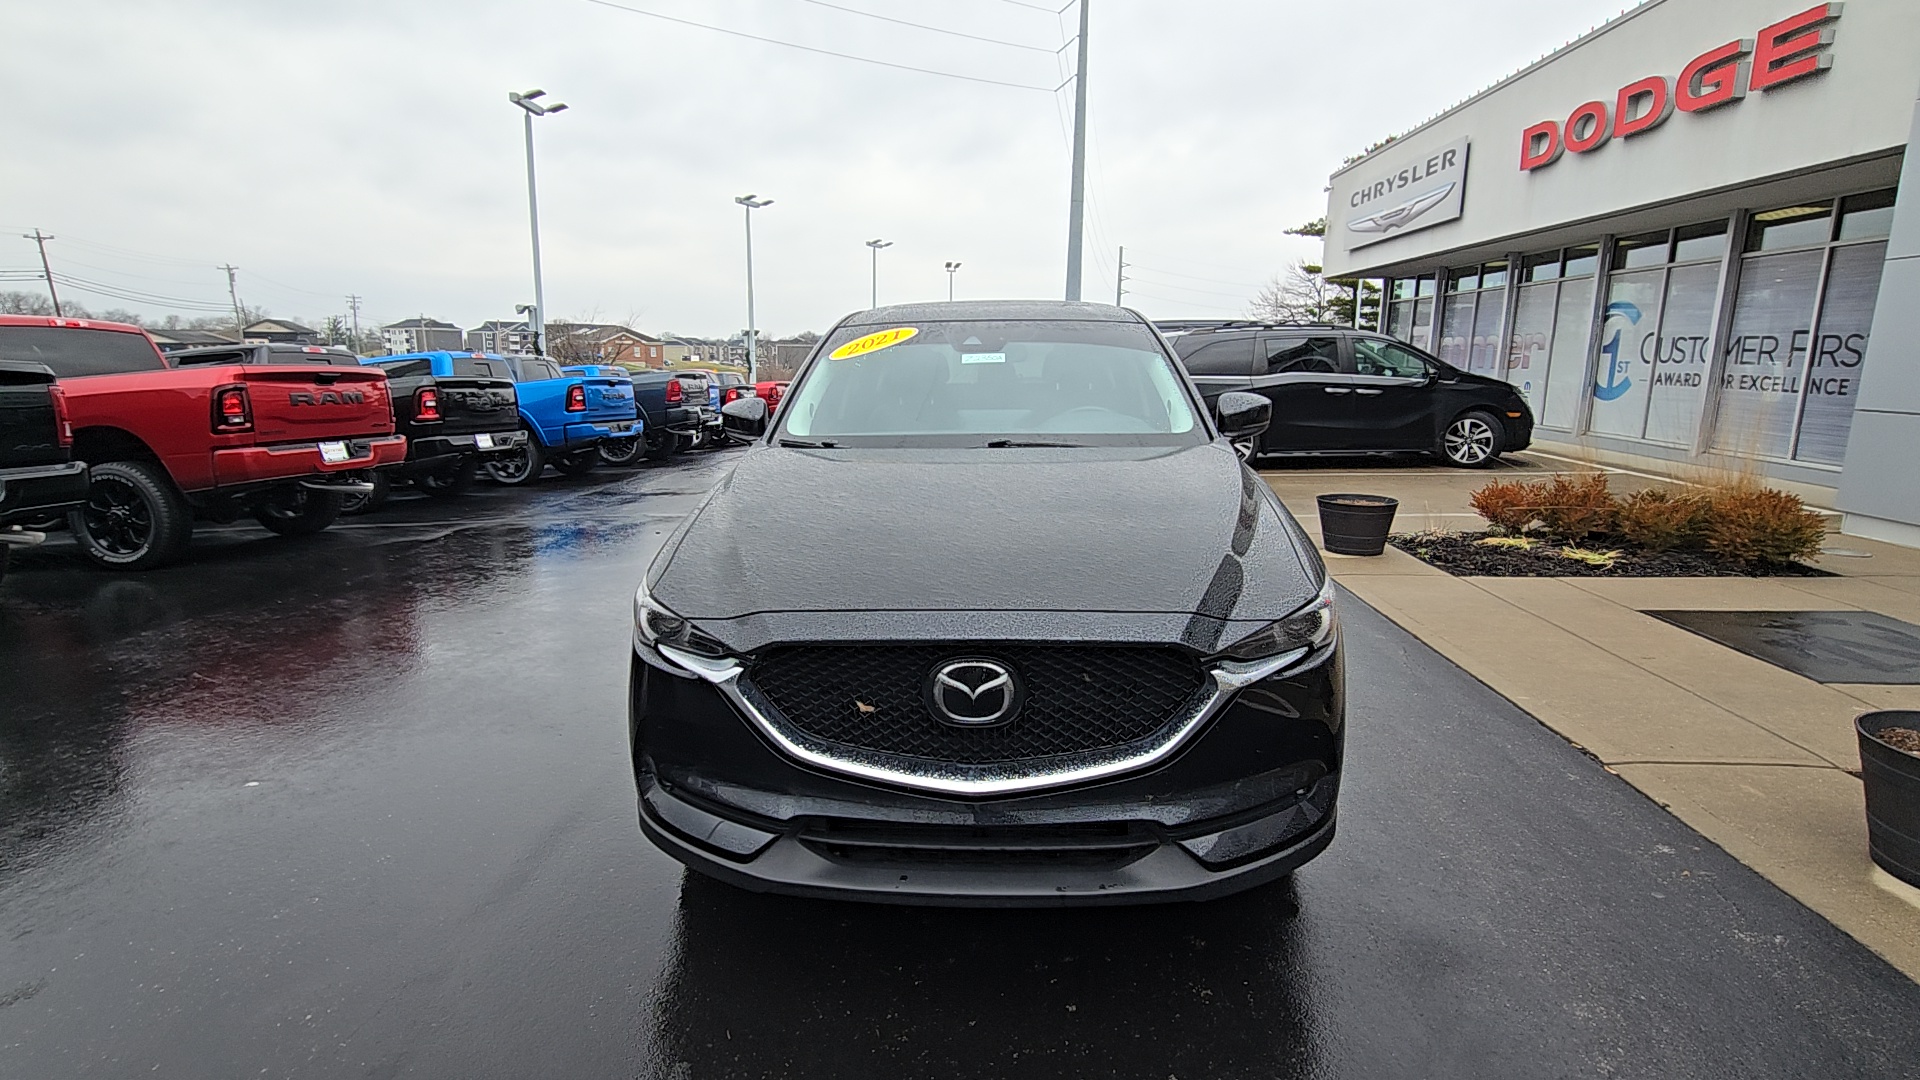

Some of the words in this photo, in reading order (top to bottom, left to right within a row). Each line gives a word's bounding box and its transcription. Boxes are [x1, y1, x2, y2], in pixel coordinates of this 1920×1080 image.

[1519, 2, 1842, 171] DODGE
[1350, 148, 1457, 208] CHRYSLER
[847, 330, 902, 356] 2021
[1787, 329, 1870, 368] FRS
[1654, 372, 1702, 388] AWARD
[1739, 374, 1851, 396] EXCELLNCE
[289, 391, 365, 407] RAM
[466, 396, 502, 407] RAM
